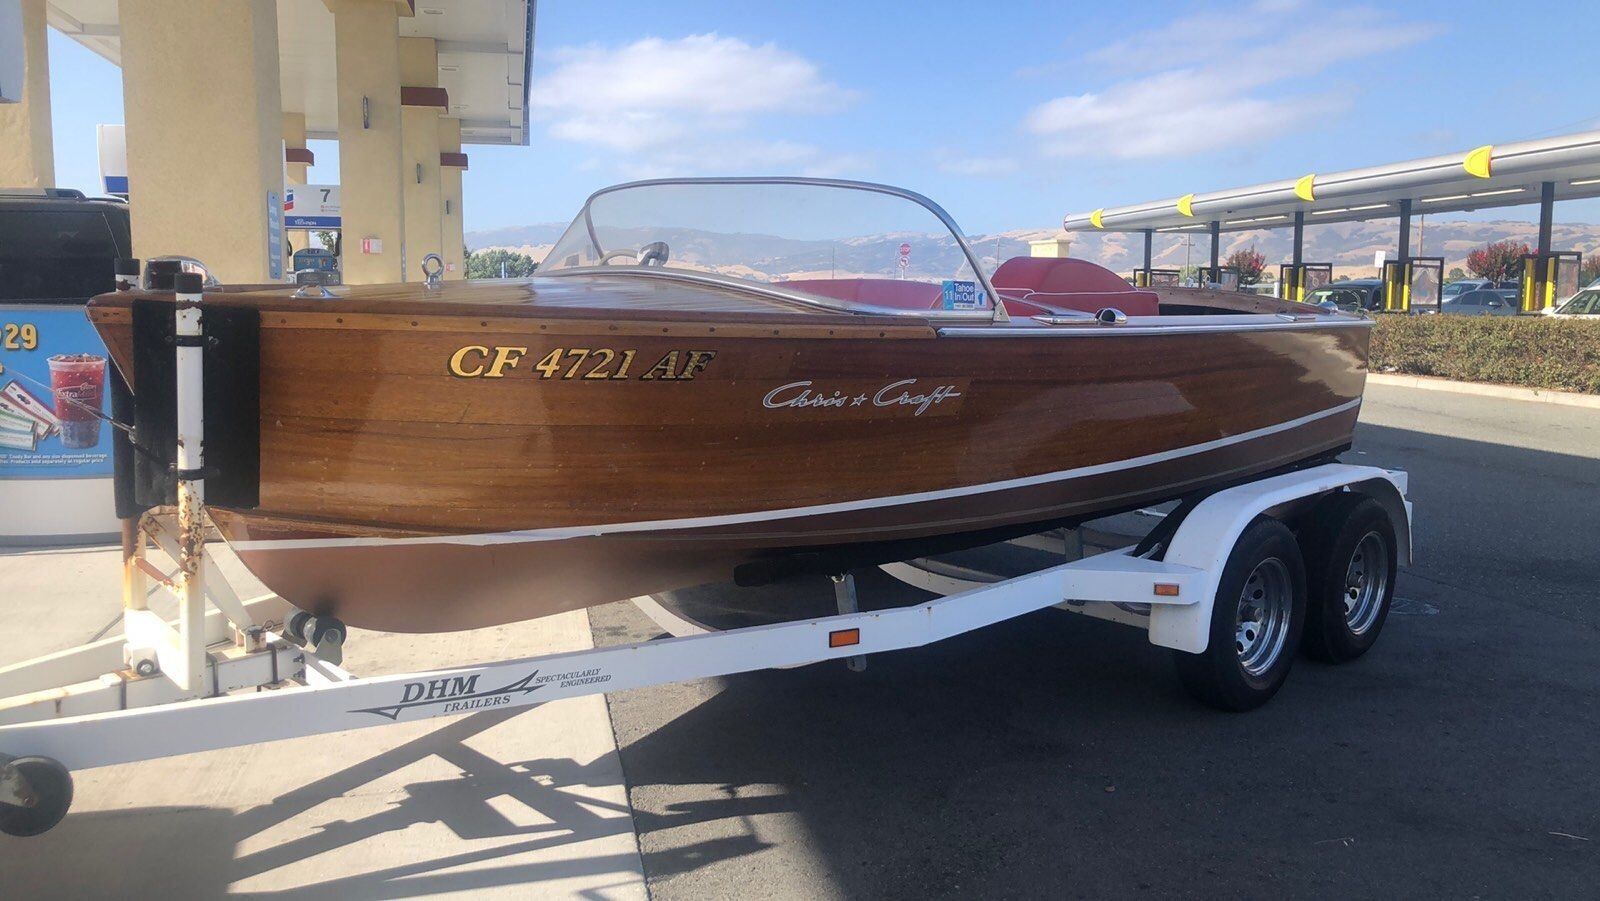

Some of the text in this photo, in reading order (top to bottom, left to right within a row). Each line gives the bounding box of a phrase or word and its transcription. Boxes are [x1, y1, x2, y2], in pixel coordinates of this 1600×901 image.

[320, 189, 330, 202] 7
[954, 283, 973, 293] Tahoe
[0, 323, 37, 349] 29
[448, 346, 717, 380] CF 4721 AF
[763, 378, 961, 417] Chris Craft
[535, 668, 601, 684] SPECTACULARLY
[560, 674, 611, 688] ENGINEERED
[401, 674, 480, 703] DHM
[443, 695, 510, 712] TRAILERS
